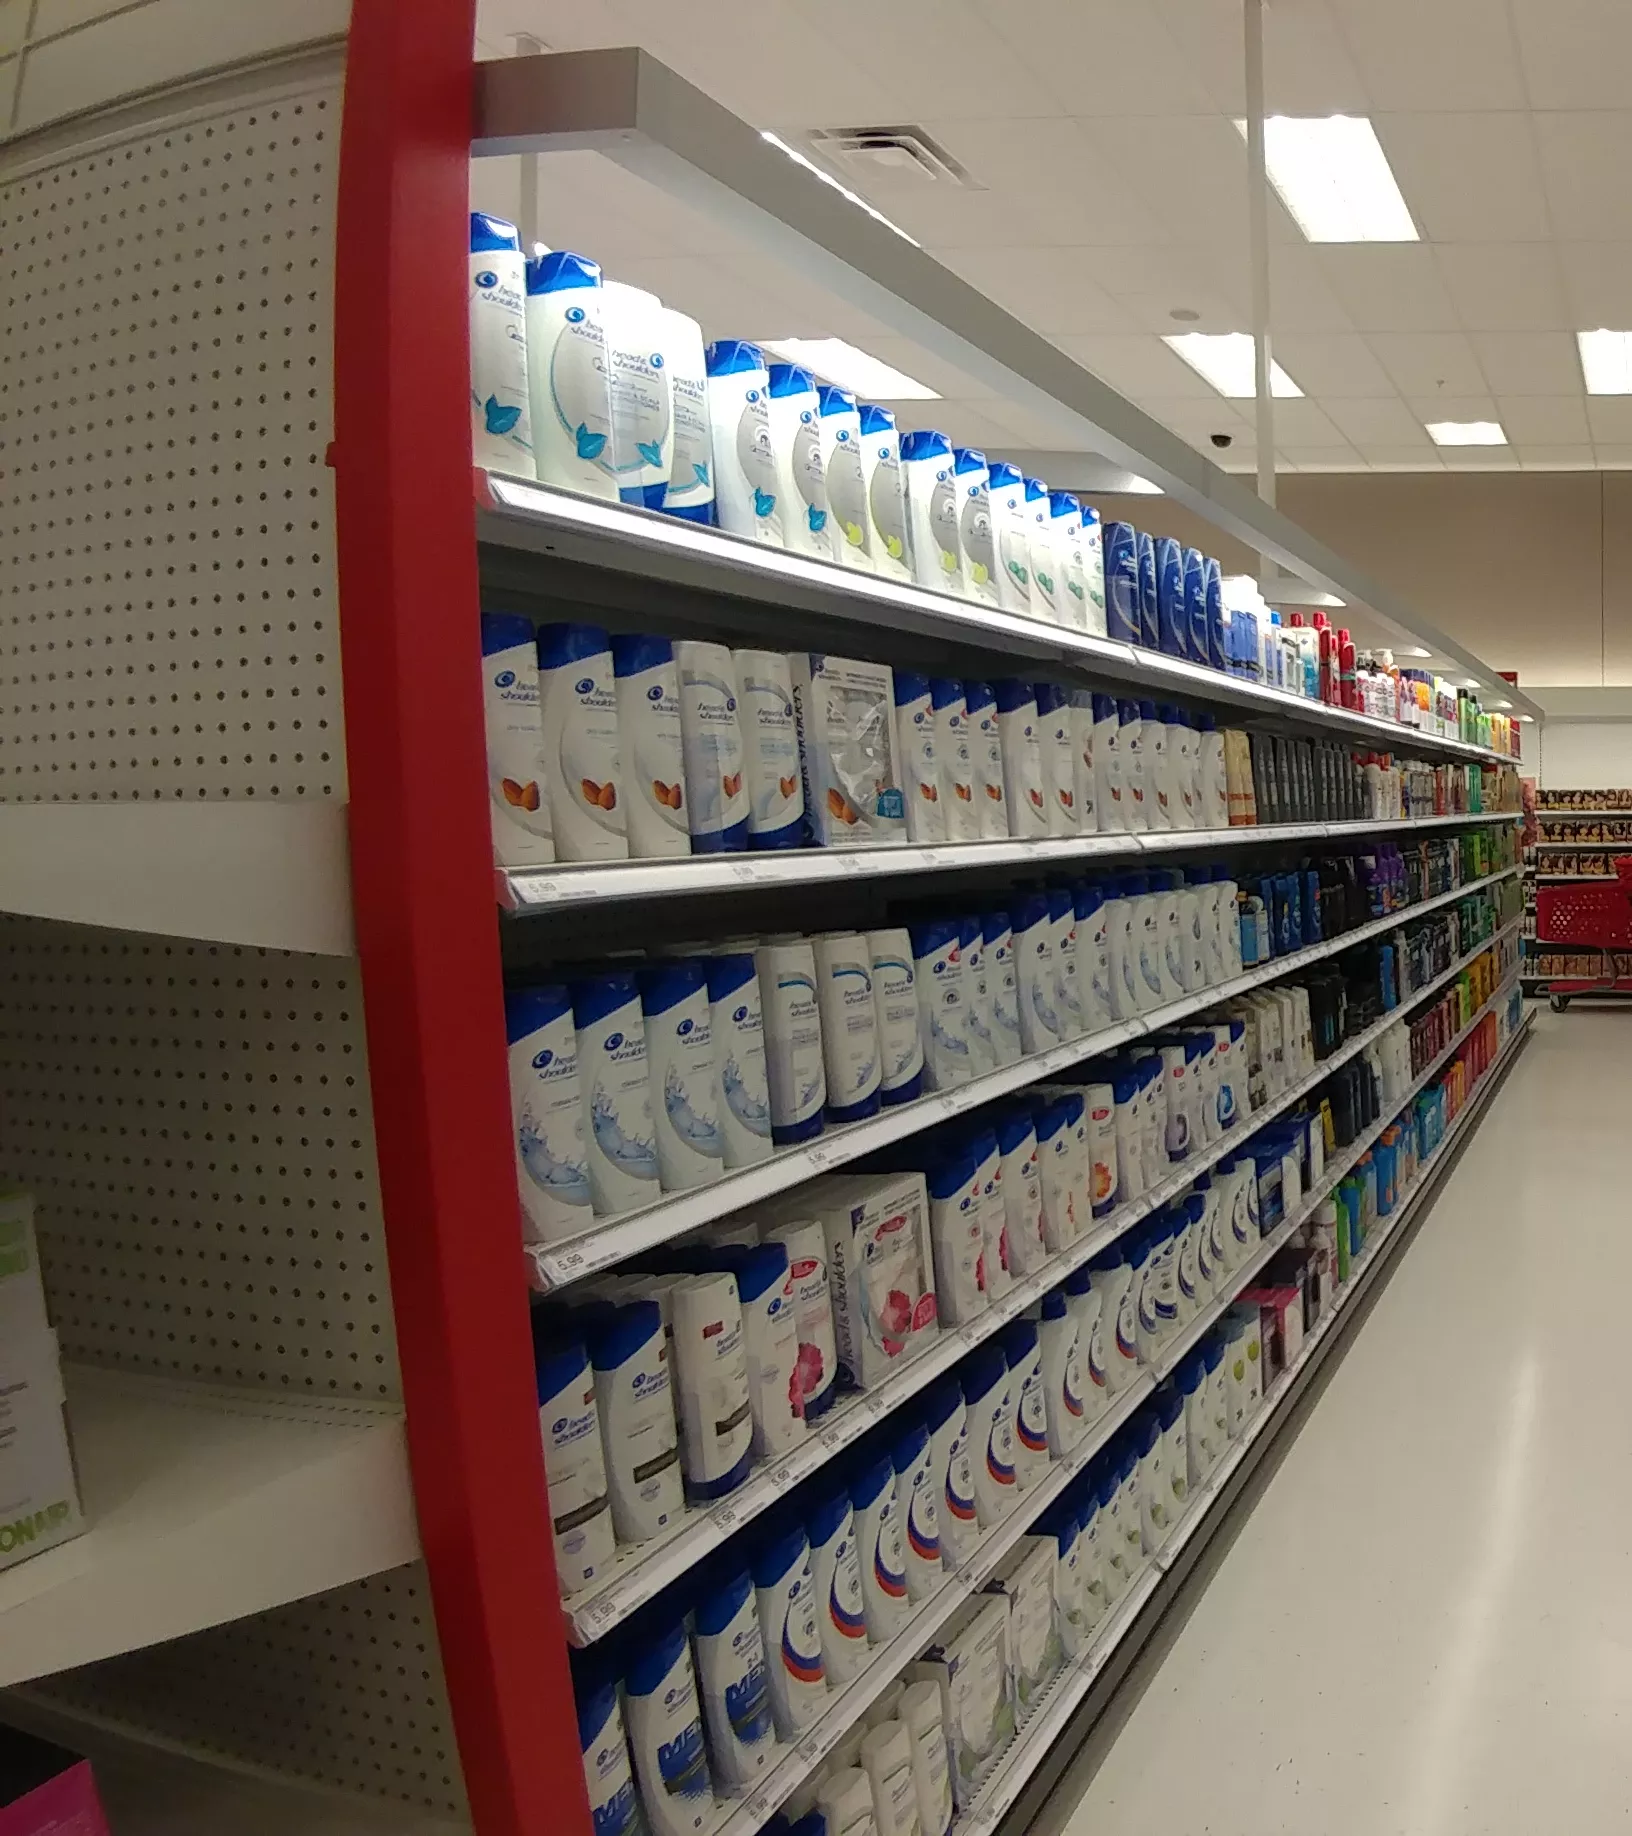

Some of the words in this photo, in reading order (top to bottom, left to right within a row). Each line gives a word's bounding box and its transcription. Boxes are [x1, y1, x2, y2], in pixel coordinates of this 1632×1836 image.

[556, 1253, 584, 1270] 5.99
[770, 1469, 791, 1487] 5.99
[0, 1500, 70, 1553] ONAIR
[590, 1602, 617, 1625] 5.99
